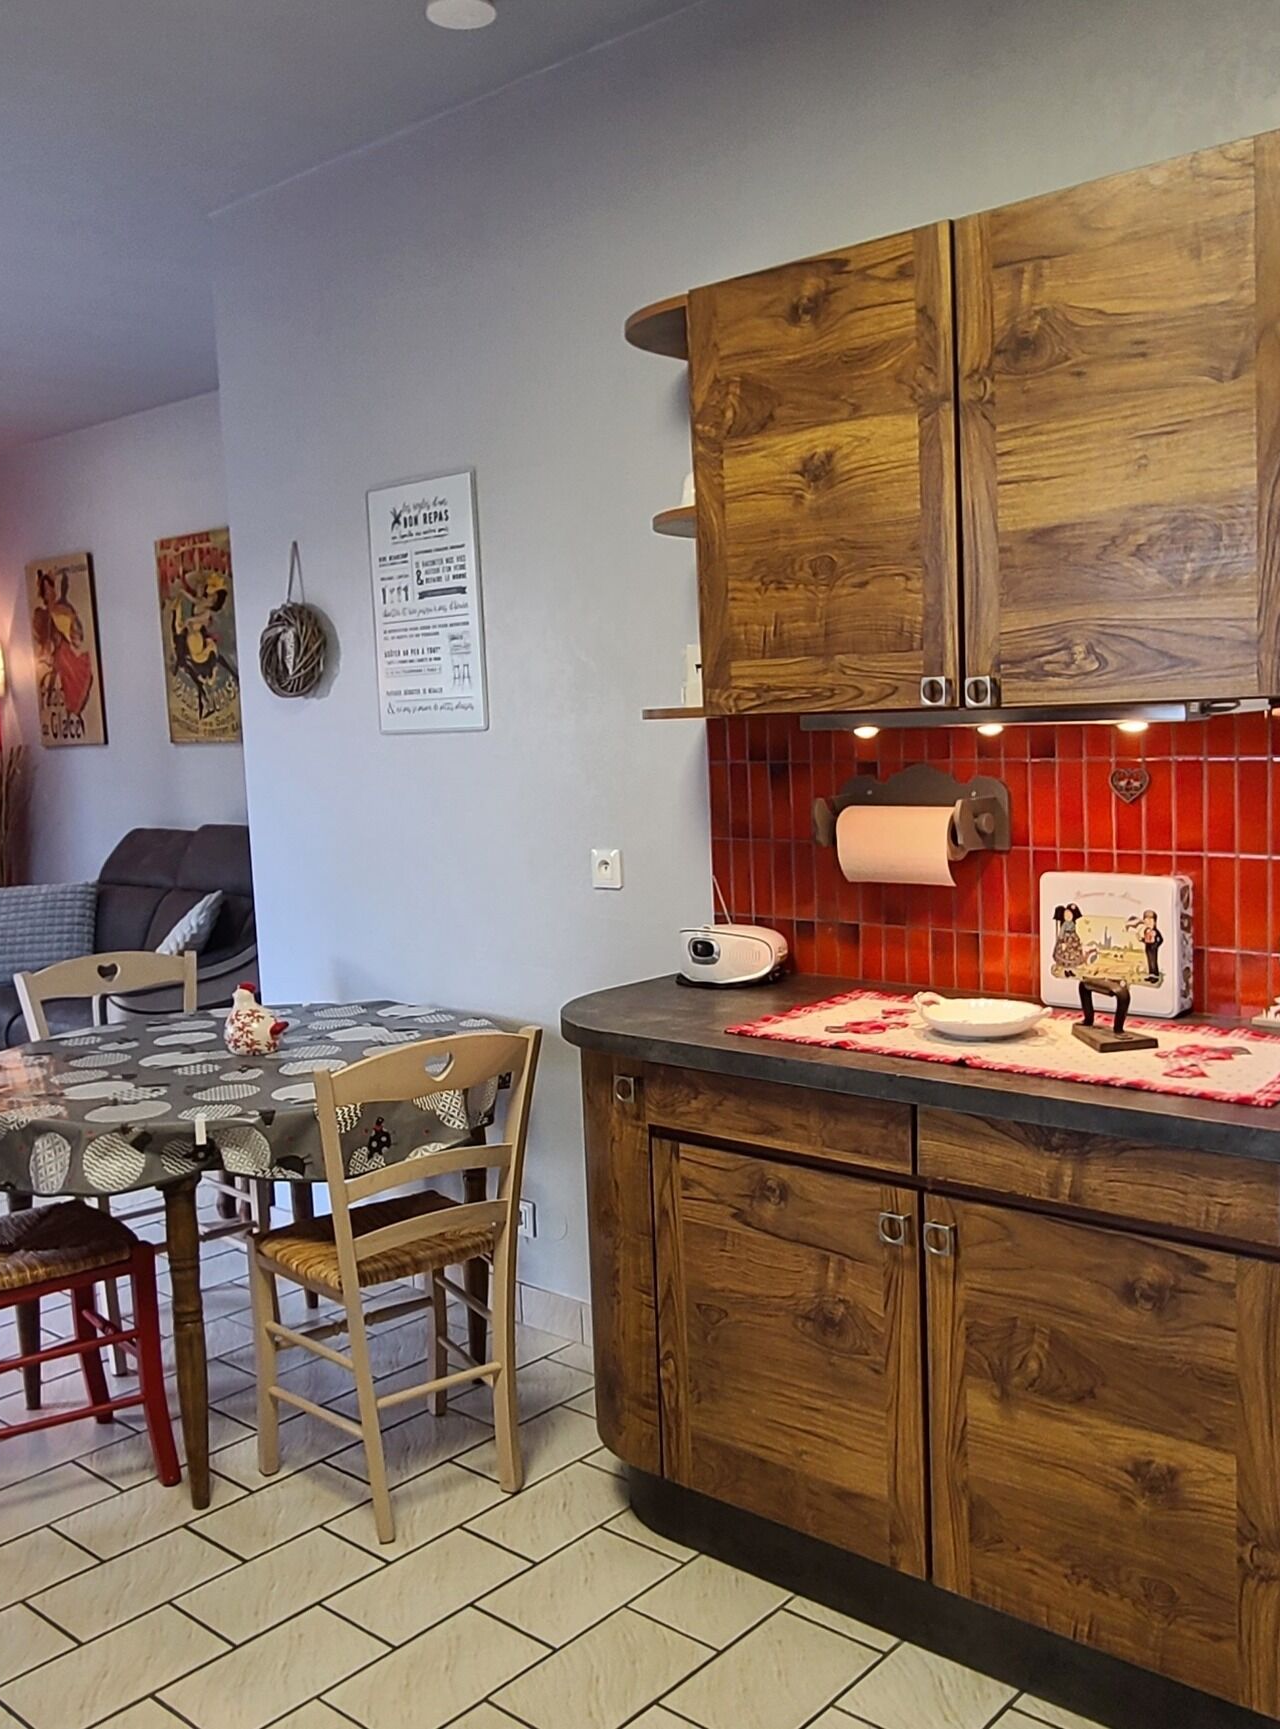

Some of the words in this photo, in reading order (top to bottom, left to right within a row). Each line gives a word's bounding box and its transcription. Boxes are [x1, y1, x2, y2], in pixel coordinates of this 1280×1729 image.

[403, 514, 419, 529] BON
[423, 509, 449, 524] REPAS
[416, 569, 424, 586] &
